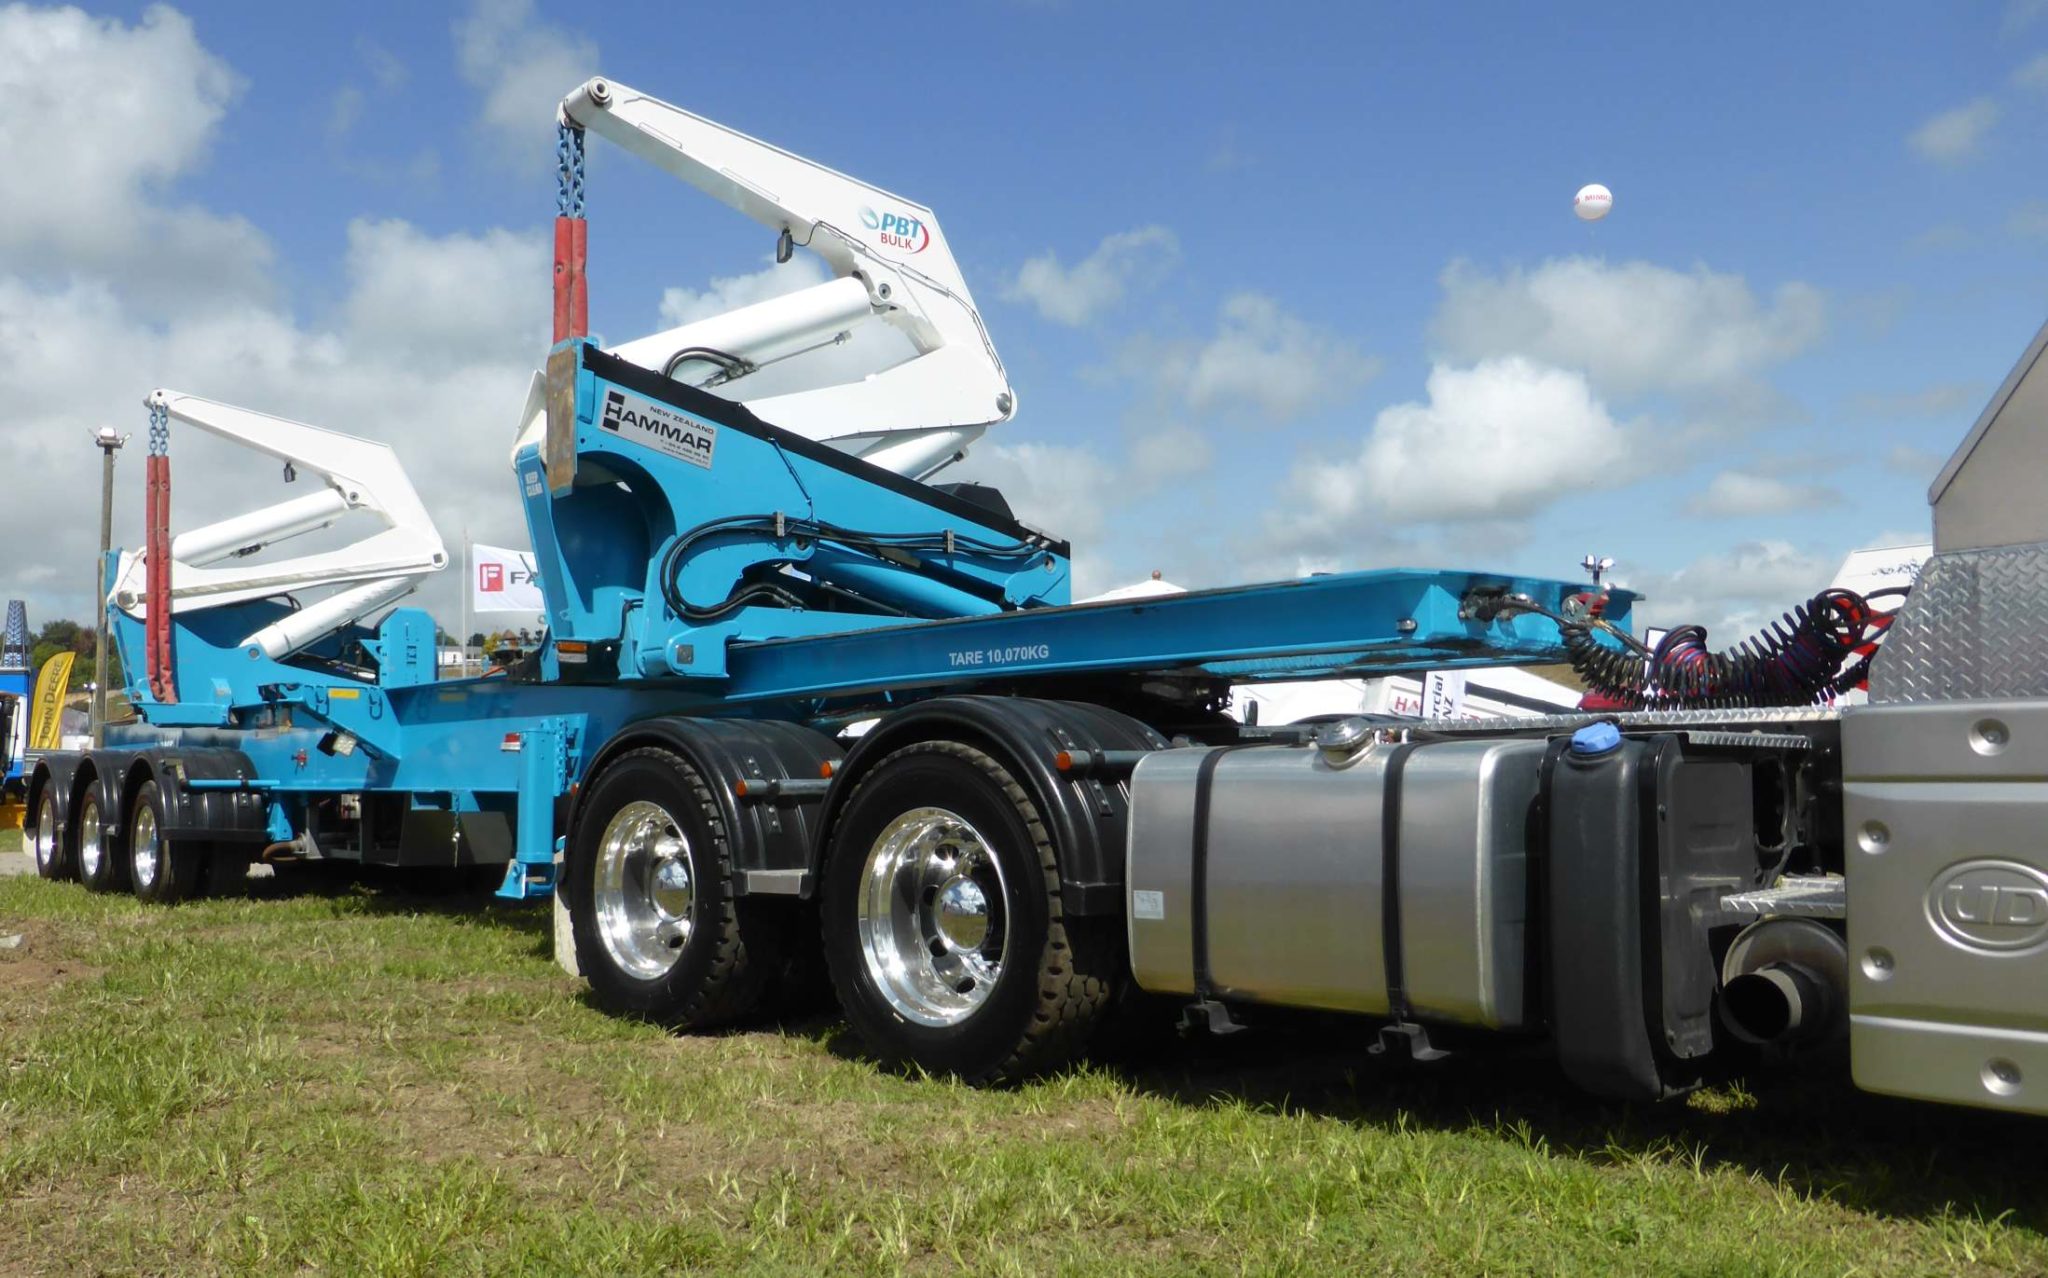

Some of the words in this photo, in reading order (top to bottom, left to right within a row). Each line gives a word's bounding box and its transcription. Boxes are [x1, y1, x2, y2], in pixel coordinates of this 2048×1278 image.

[881, 213, 923, 238] PBT
[881, 232, 912, 250] BULK
[605, 402, 712, 454] HAMMAR
[650, 406, 671, 418] NEW
[673, 415, 714, 435] ZEALAND
[949, 651, 983, 666] TARE
[987, 644, 1049, 664] 10,070KG
[44, 660, 63, 704] DEERE
[40, 707, 54, 740] JOHN
[1948, 884, 2046, 926] UD
